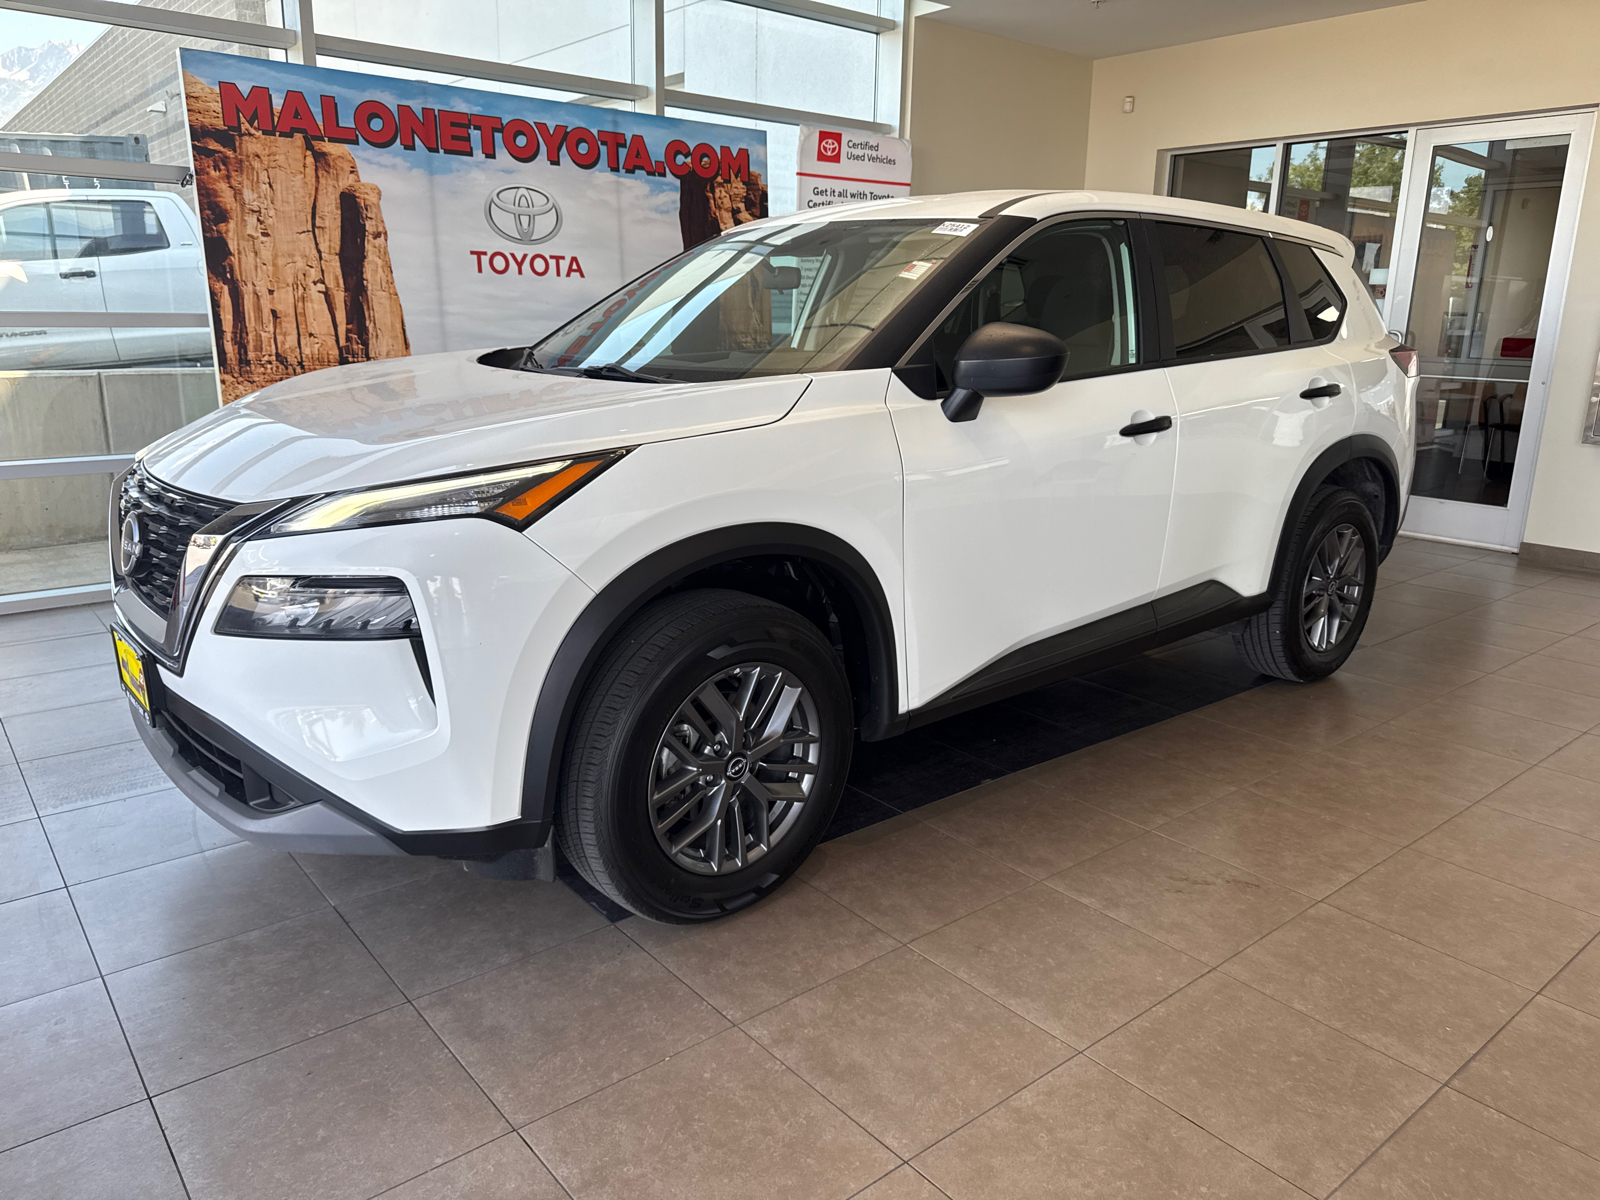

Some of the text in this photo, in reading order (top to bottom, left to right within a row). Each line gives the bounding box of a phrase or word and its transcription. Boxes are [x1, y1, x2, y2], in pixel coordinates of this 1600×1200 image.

[218, 81, 750, 183] MALONETOYOTA.COM
[846, 139, 879, 151] Certified
[846, 150, 896, 165] Used Vehicles
[812, 186, 828, 197] Get
[829, 187, 836, 198] it
[837, 188, 848, 199] all
[849, 190, 868, 200] with
[469, 250, 586, 279] TOYOTA
